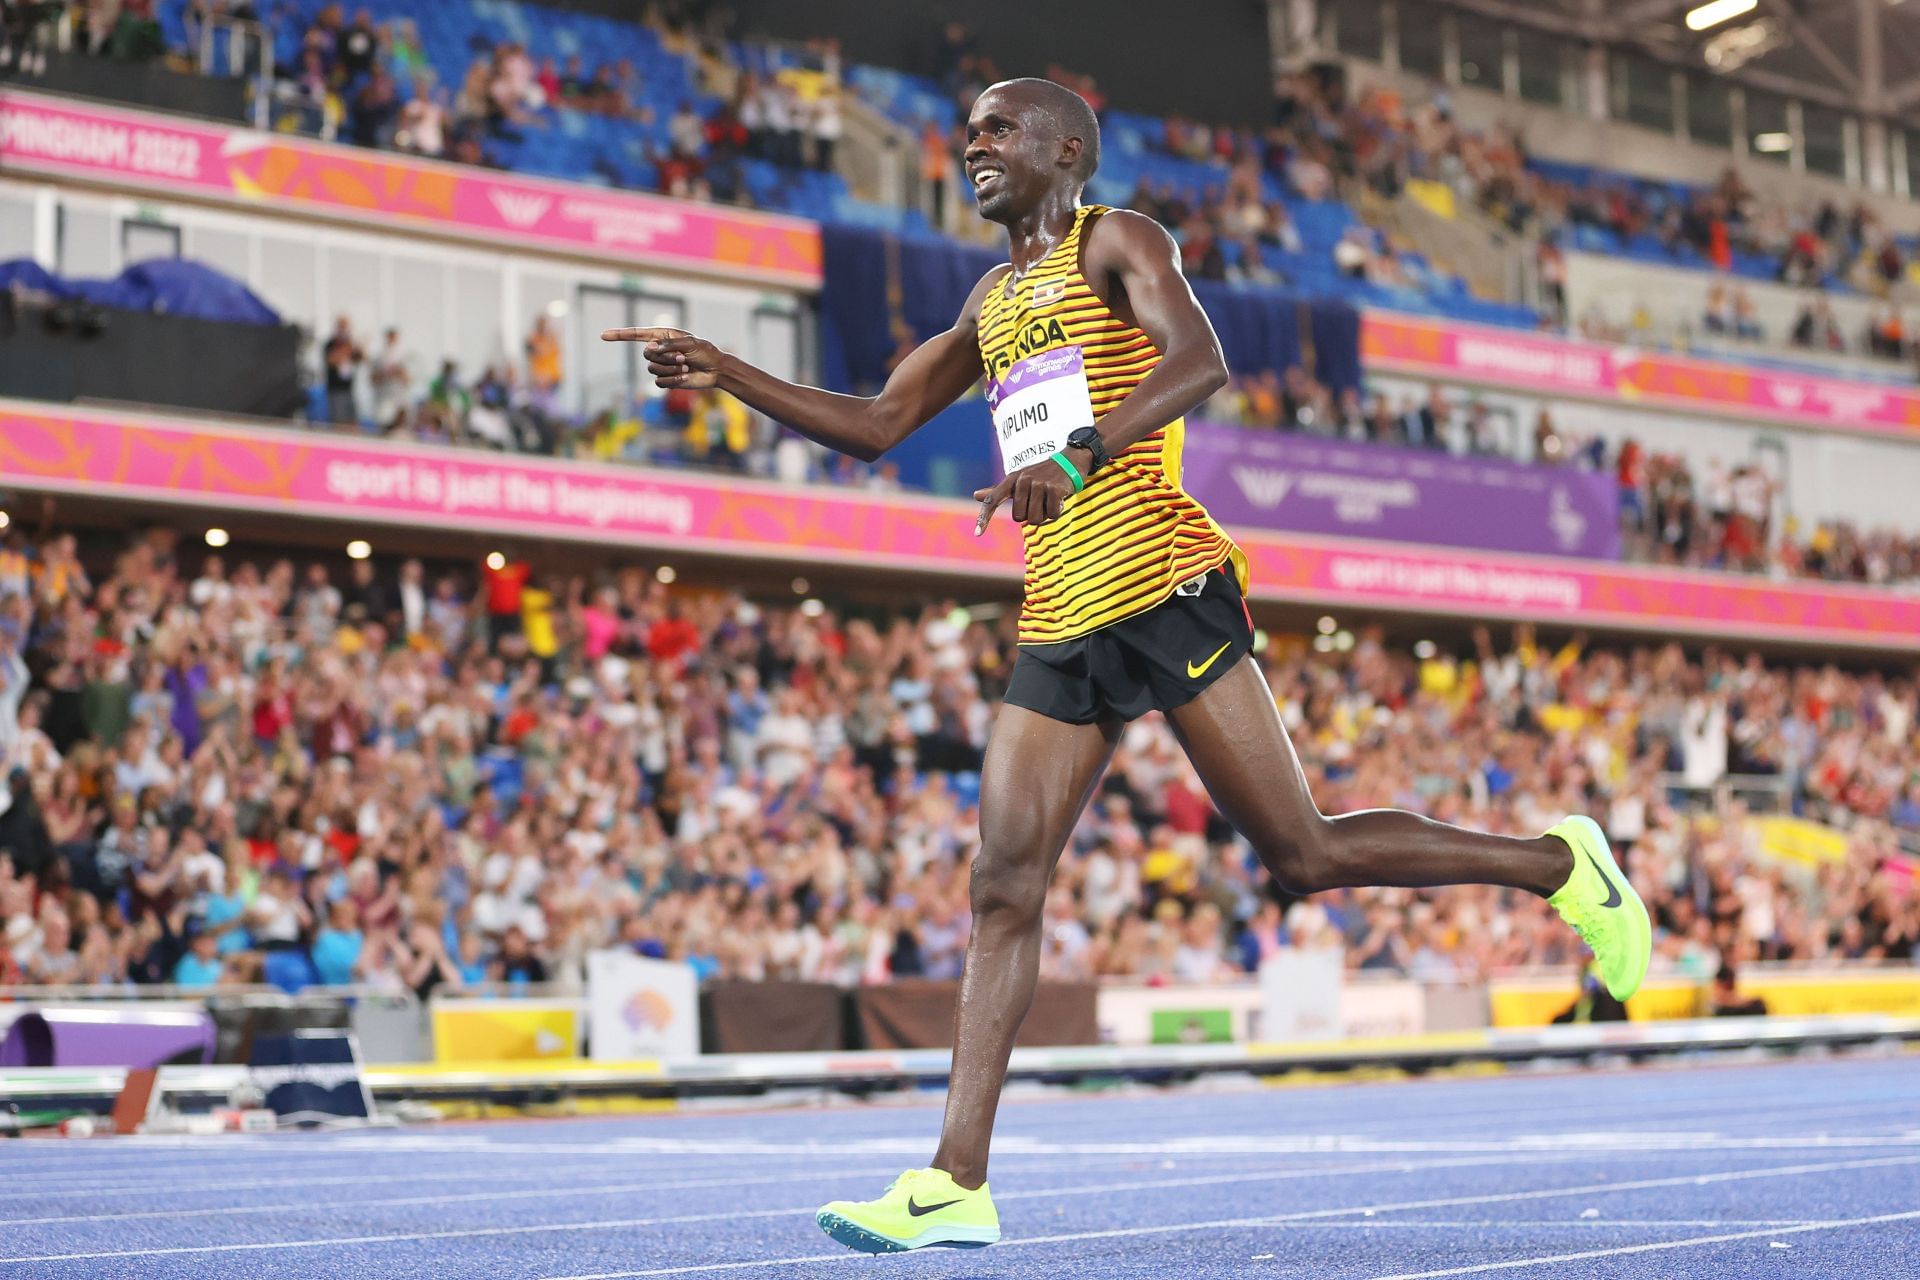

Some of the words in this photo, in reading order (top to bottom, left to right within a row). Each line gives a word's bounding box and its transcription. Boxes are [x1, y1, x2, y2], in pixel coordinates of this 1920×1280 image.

[1002, 402, 1049, 441] KIPLIMO
[1008, 440, 1056, 471] ONGINES
[327, 459, 409, 504] sport
[413, 461, 442, 505] is
[443, 464, 500, 513] just
[502, 473, 549, 516] the
[552, 474, 694, 536] beginning
